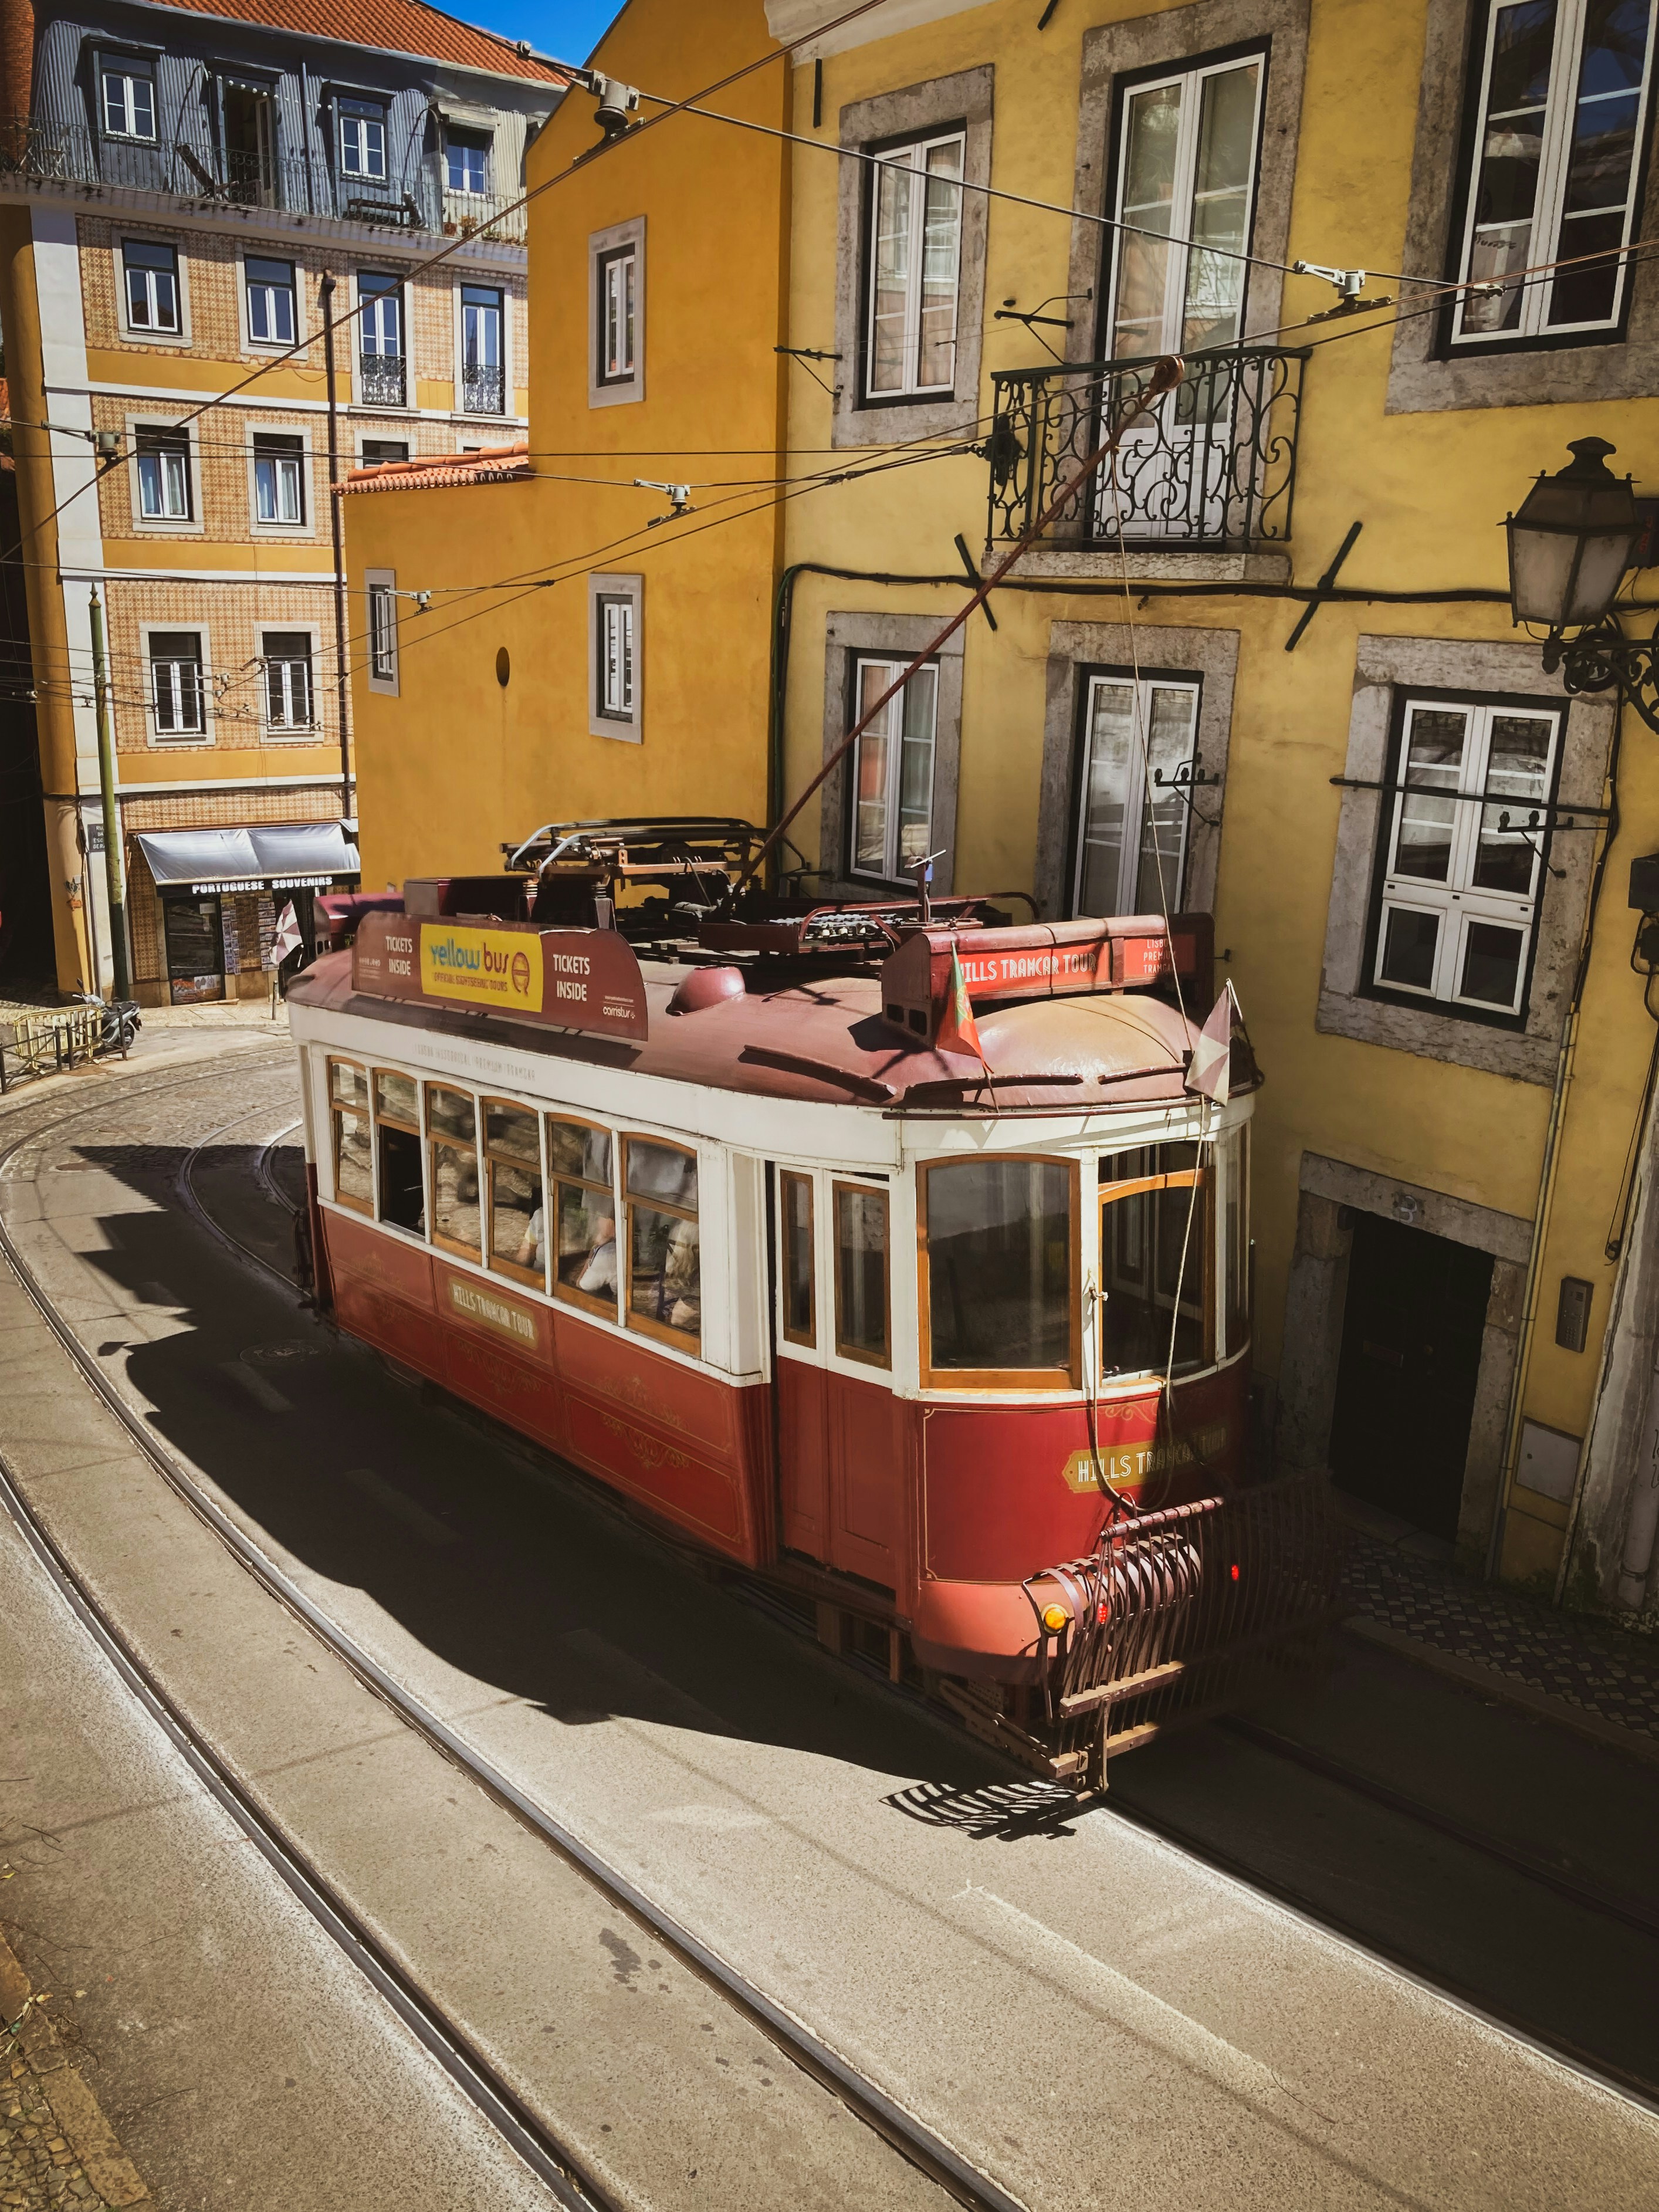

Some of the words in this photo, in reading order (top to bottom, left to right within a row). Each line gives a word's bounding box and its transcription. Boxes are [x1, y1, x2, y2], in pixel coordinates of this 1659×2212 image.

[192, 881, 264, 894] PORTUGUESE
[272, 877, 333, 889] SOUVENIRS
[385, 936, 412, 953] TICKETS
[388, 958, 411, 976] INSIDE
[483, 942, 509, 974] bus
[553, 954, 590, 975] TICKETS
[1000, 956, 1059, 979] TRAMCAR
[1062, 953, 1096, 974] TOUR
[556, 980, 587, 1002] INSIDE
[1400, 1195, 1418, 1224] 3
[1078, 1455, 1132, 1483] HILLS
